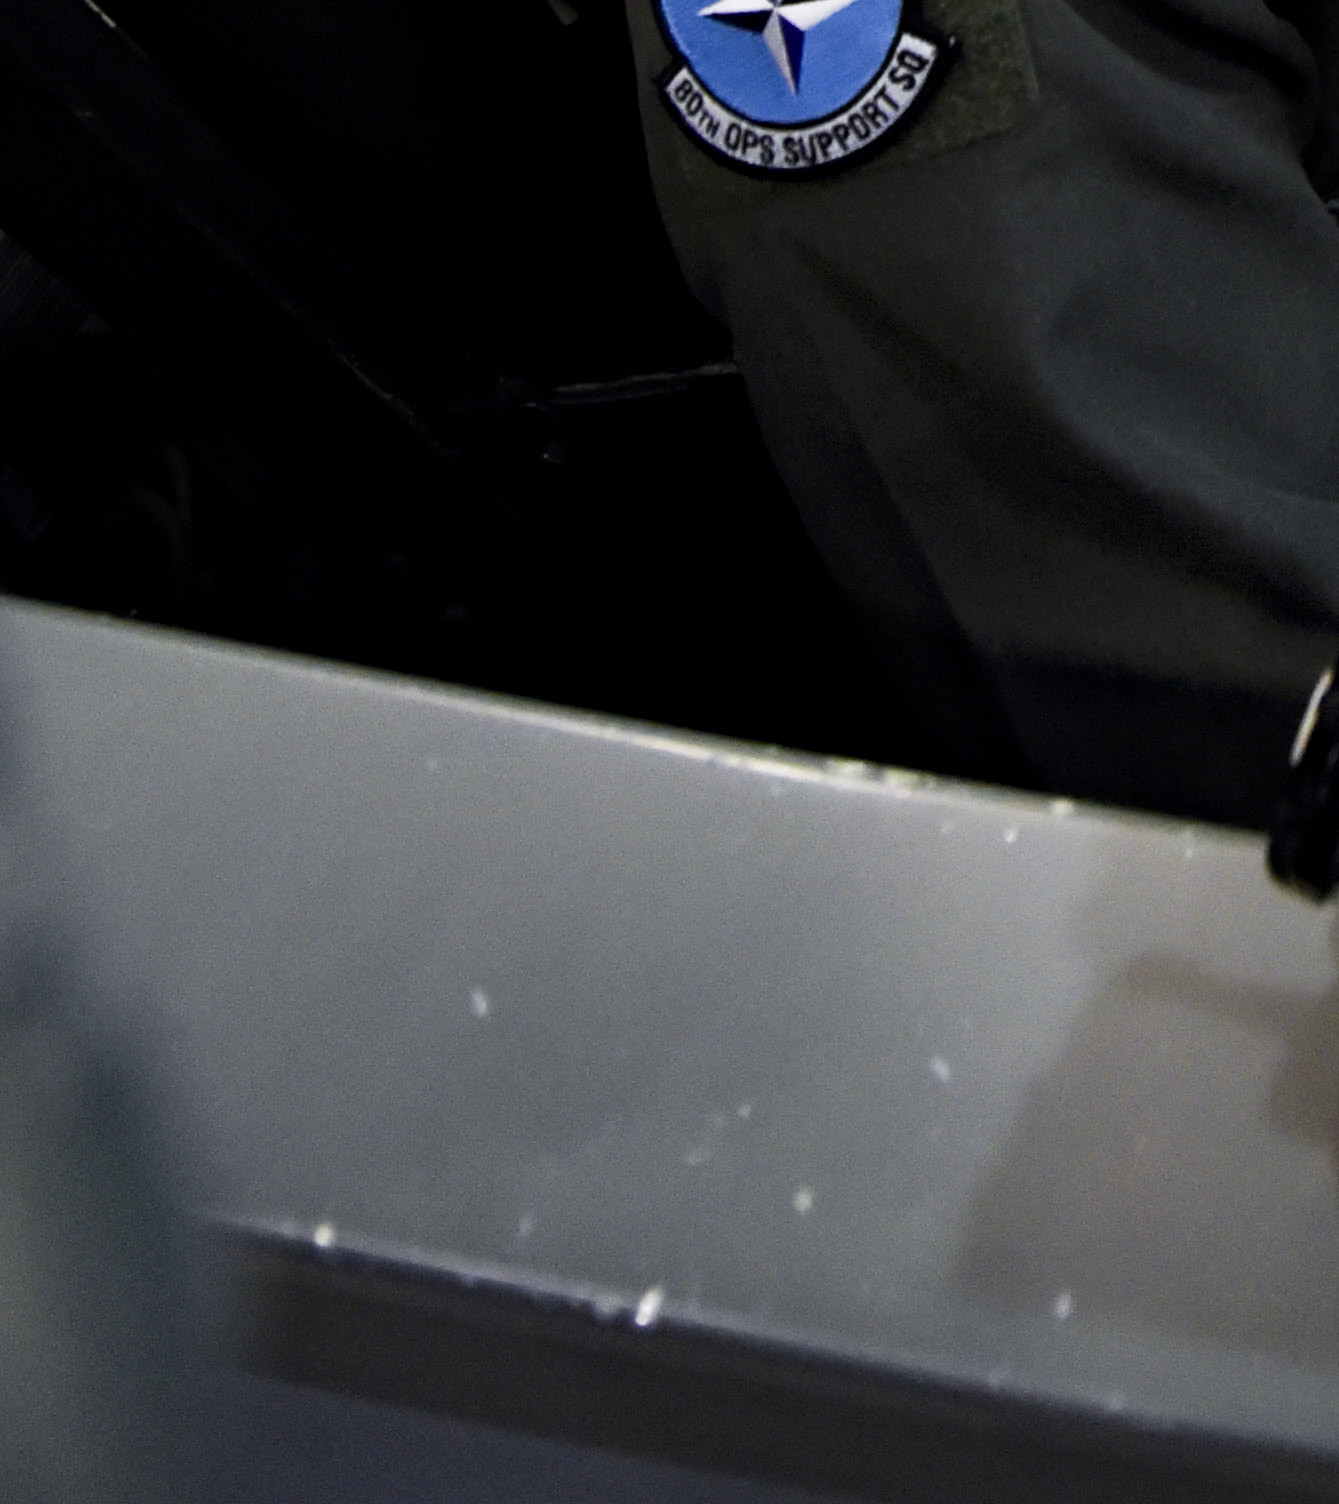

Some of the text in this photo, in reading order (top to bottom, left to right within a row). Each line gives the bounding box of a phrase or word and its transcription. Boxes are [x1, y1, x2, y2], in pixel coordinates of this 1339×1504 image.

[724, 123, 775, 165] OPS
[784, 92, 900, 164] SUPPORT
[891, 48, 929, 94] SQ
